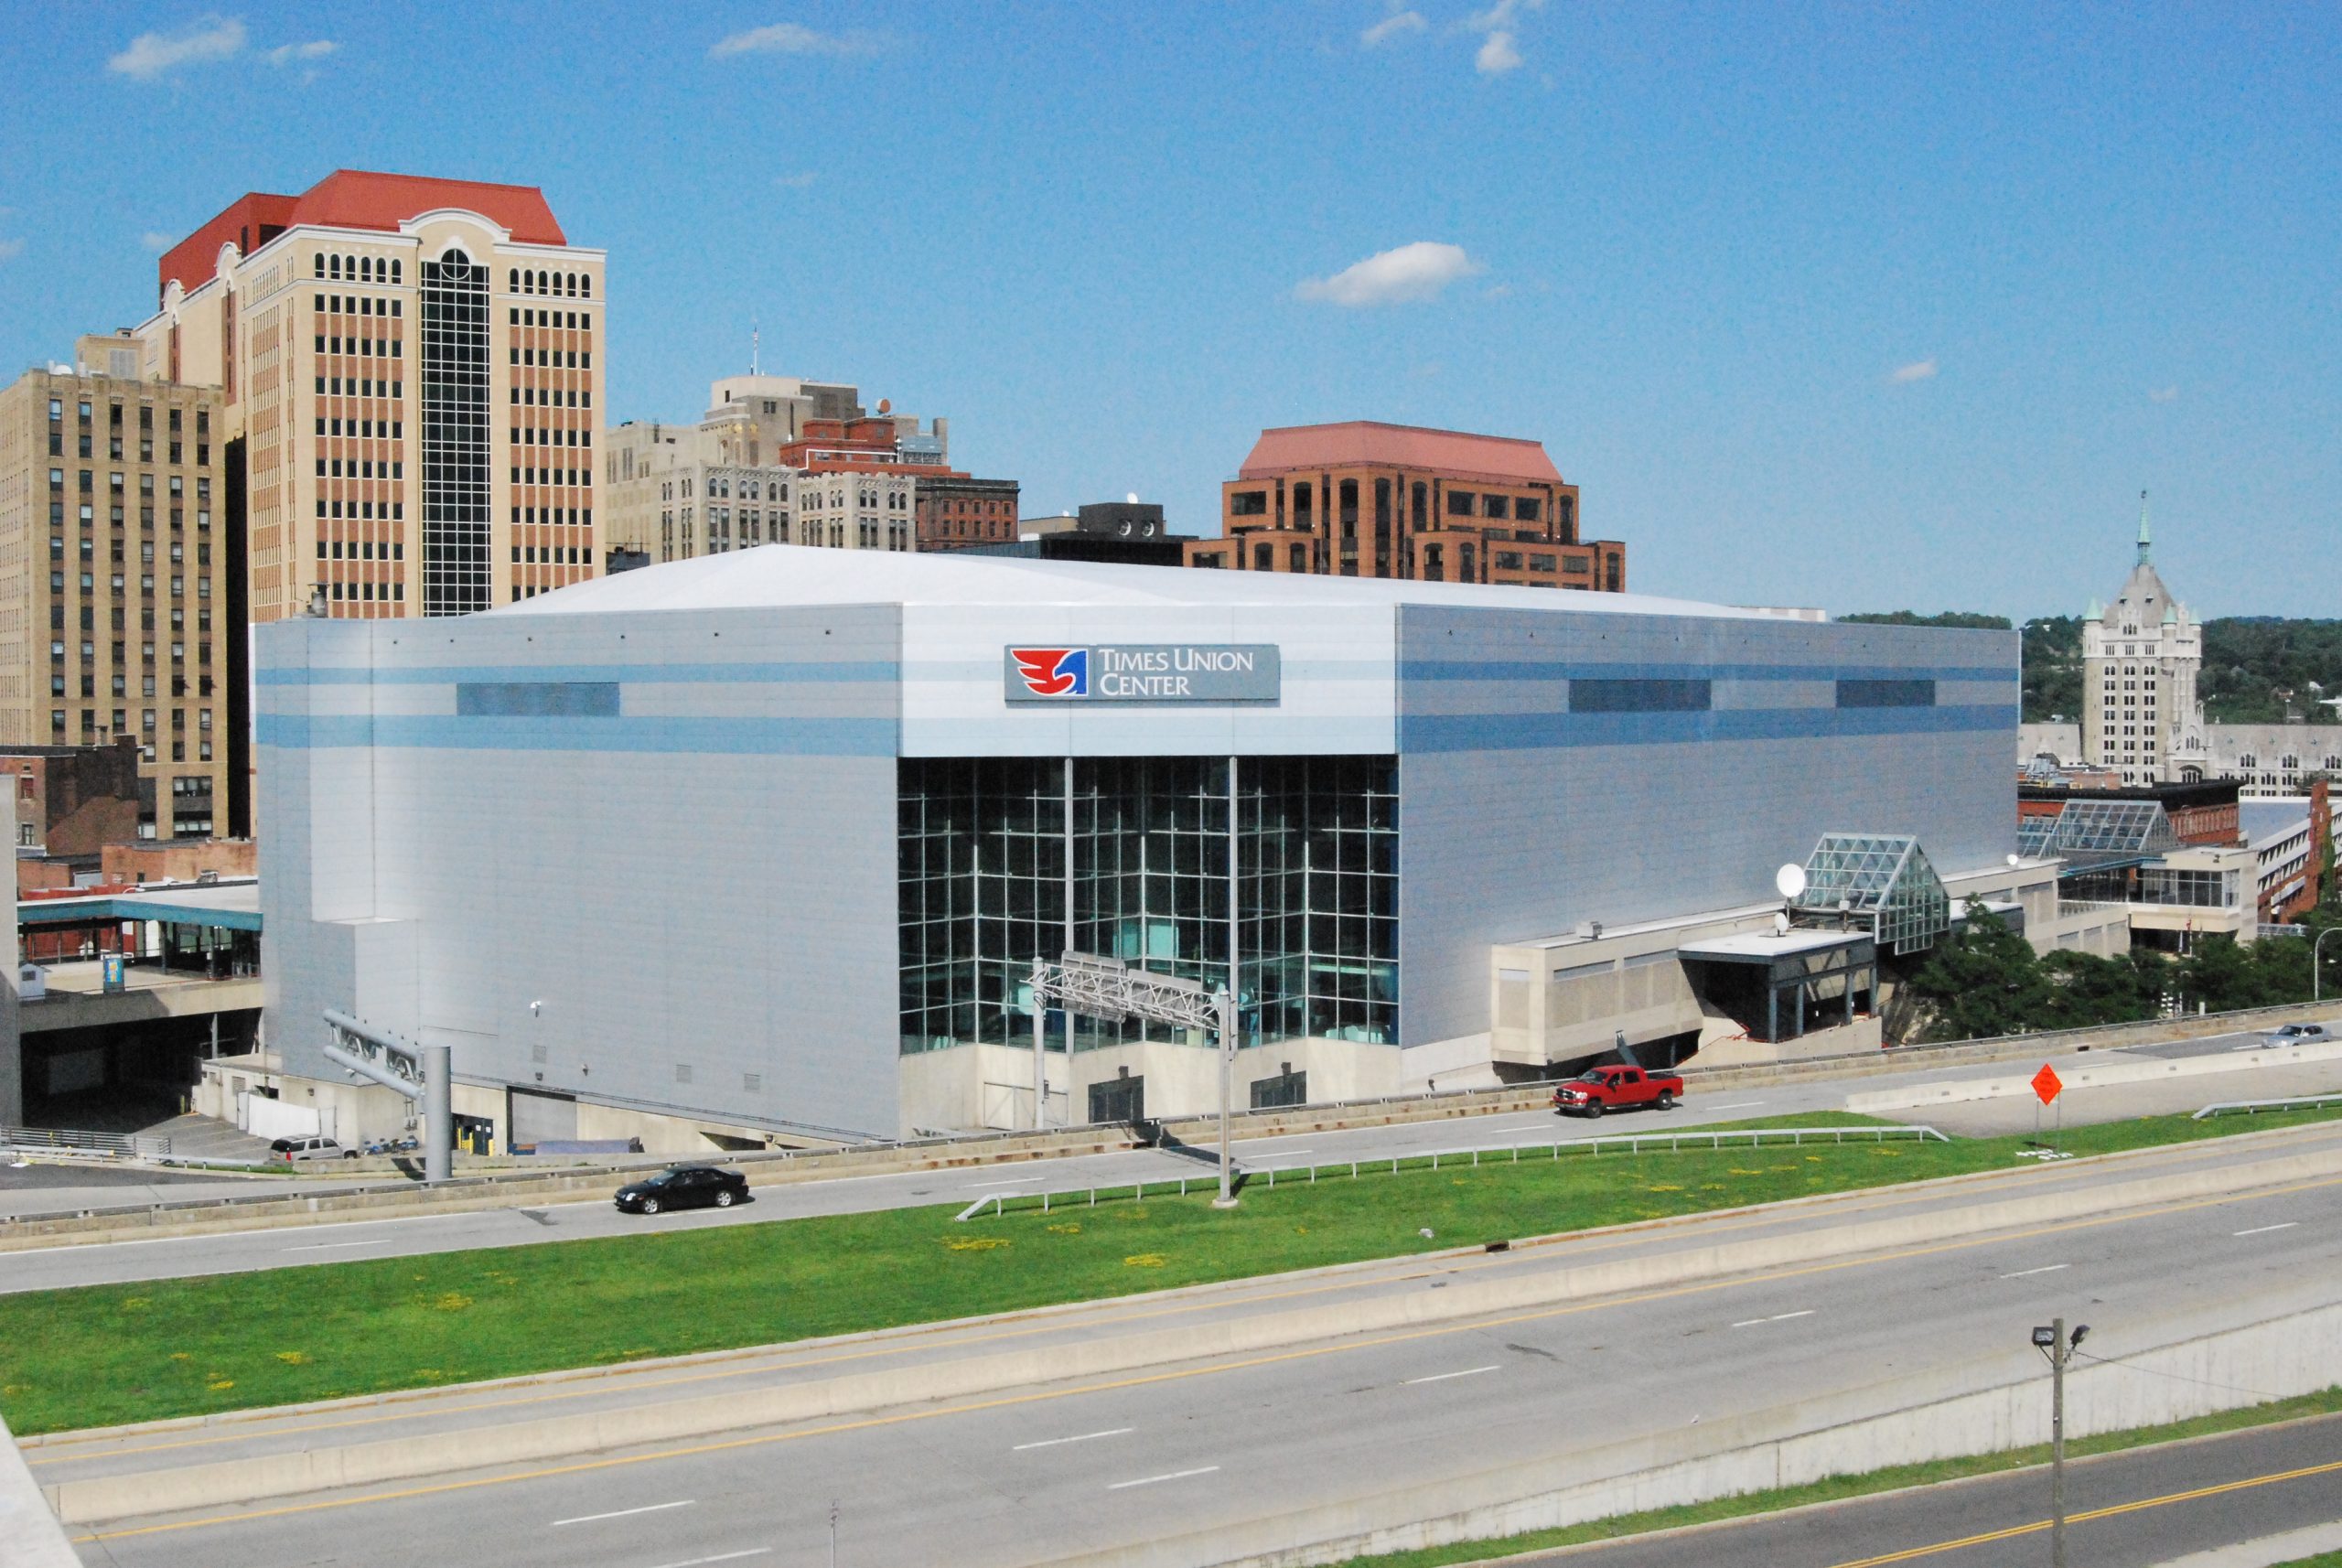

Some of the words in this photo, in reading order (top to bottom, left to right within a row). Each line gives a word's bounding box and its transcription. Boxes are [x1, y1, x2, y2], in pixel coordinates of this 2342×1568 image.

[1098, 649, 1168, 671] TIMES
[1174, 649, 1253, 671] UNION
[1100, 672, 1190, 696] CENTER
